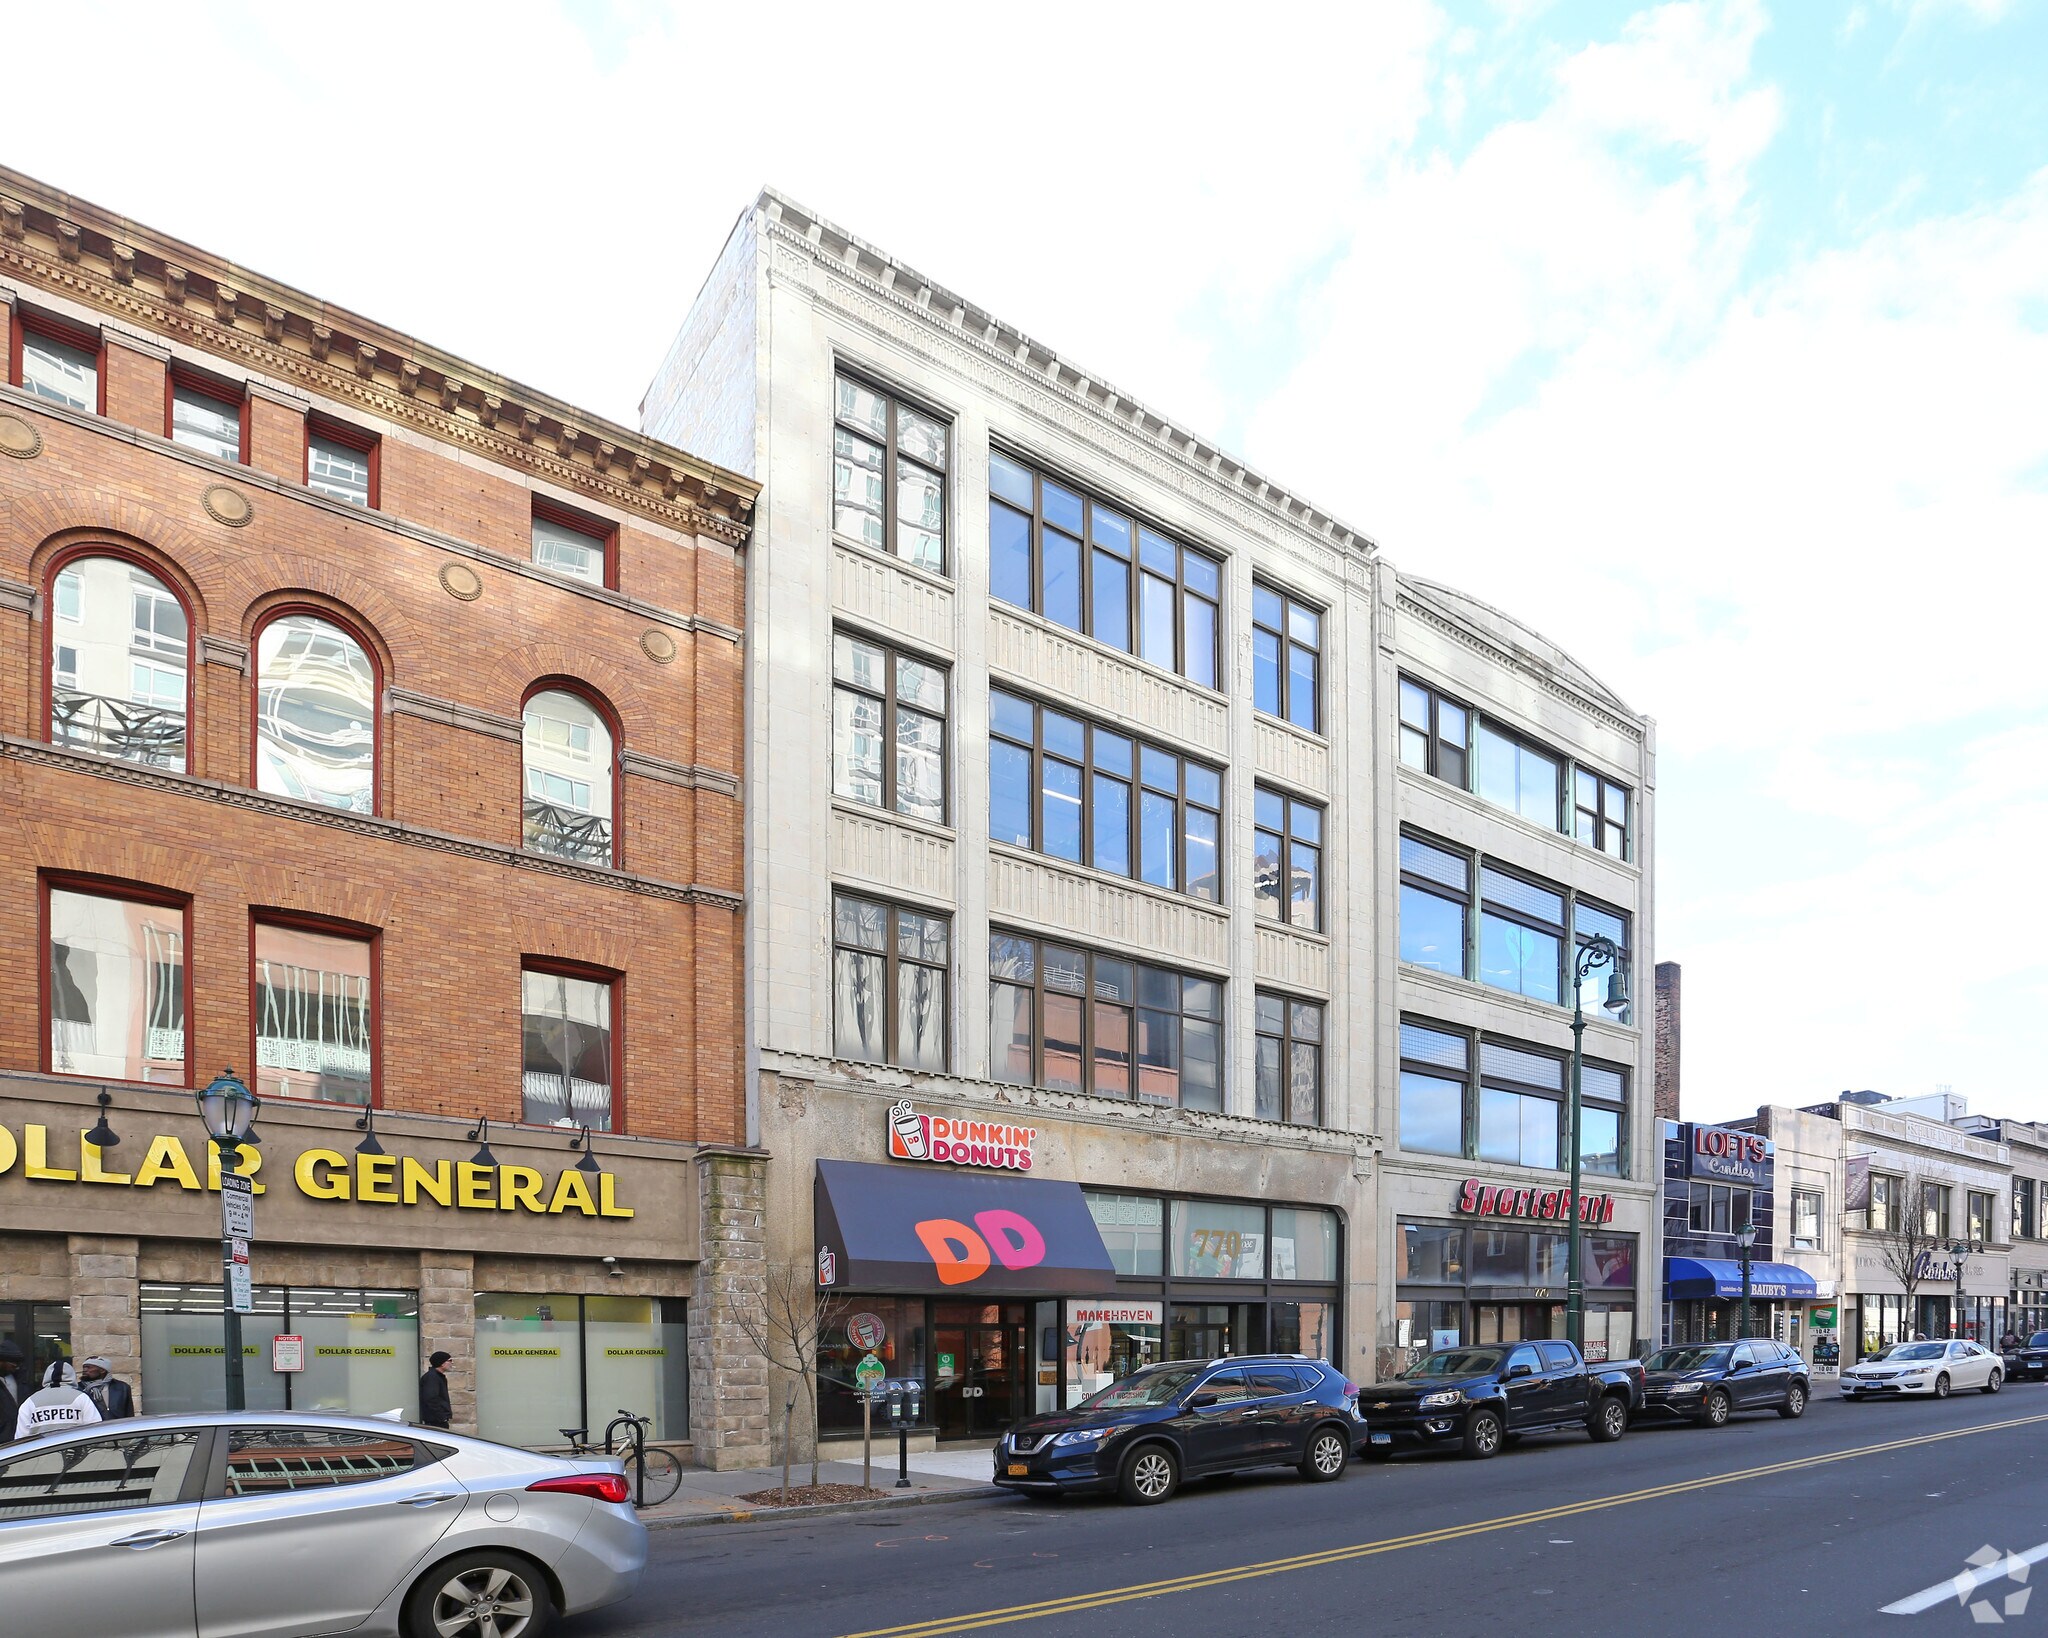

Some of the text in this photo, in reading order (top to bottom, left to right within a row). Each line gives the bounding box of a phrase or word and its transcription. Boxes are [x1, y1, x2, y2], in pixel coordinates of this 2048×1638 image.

[933, 1117, 1036, 1148] DUNKIN'
[933, 1140, 1032, 1170] DONUTS
[1695, 1127, 1765, 1164] LOFT'S
[0, 1123, 635, 1218] LLAR GENERAL
[1708, 1157, 1755, 1179] Candies
[222, 1176, 251, 1191] LOADING ZONE
[226, 1191, 249, 1203] Commercial
[226, 1201, 250, 1213] Vehicles Only
[915, 1209, 1046, 1285] DD
[1195, 1229, 1241, 1259] 770
[1751, 1283, 1787, 1297] BAUBY'S
[1076, 1309, 1153, 1321] MAKEHAVEN
[962, 1386, 983, 1398] DD
[30, 1408, 81, 1424] RESPECT
